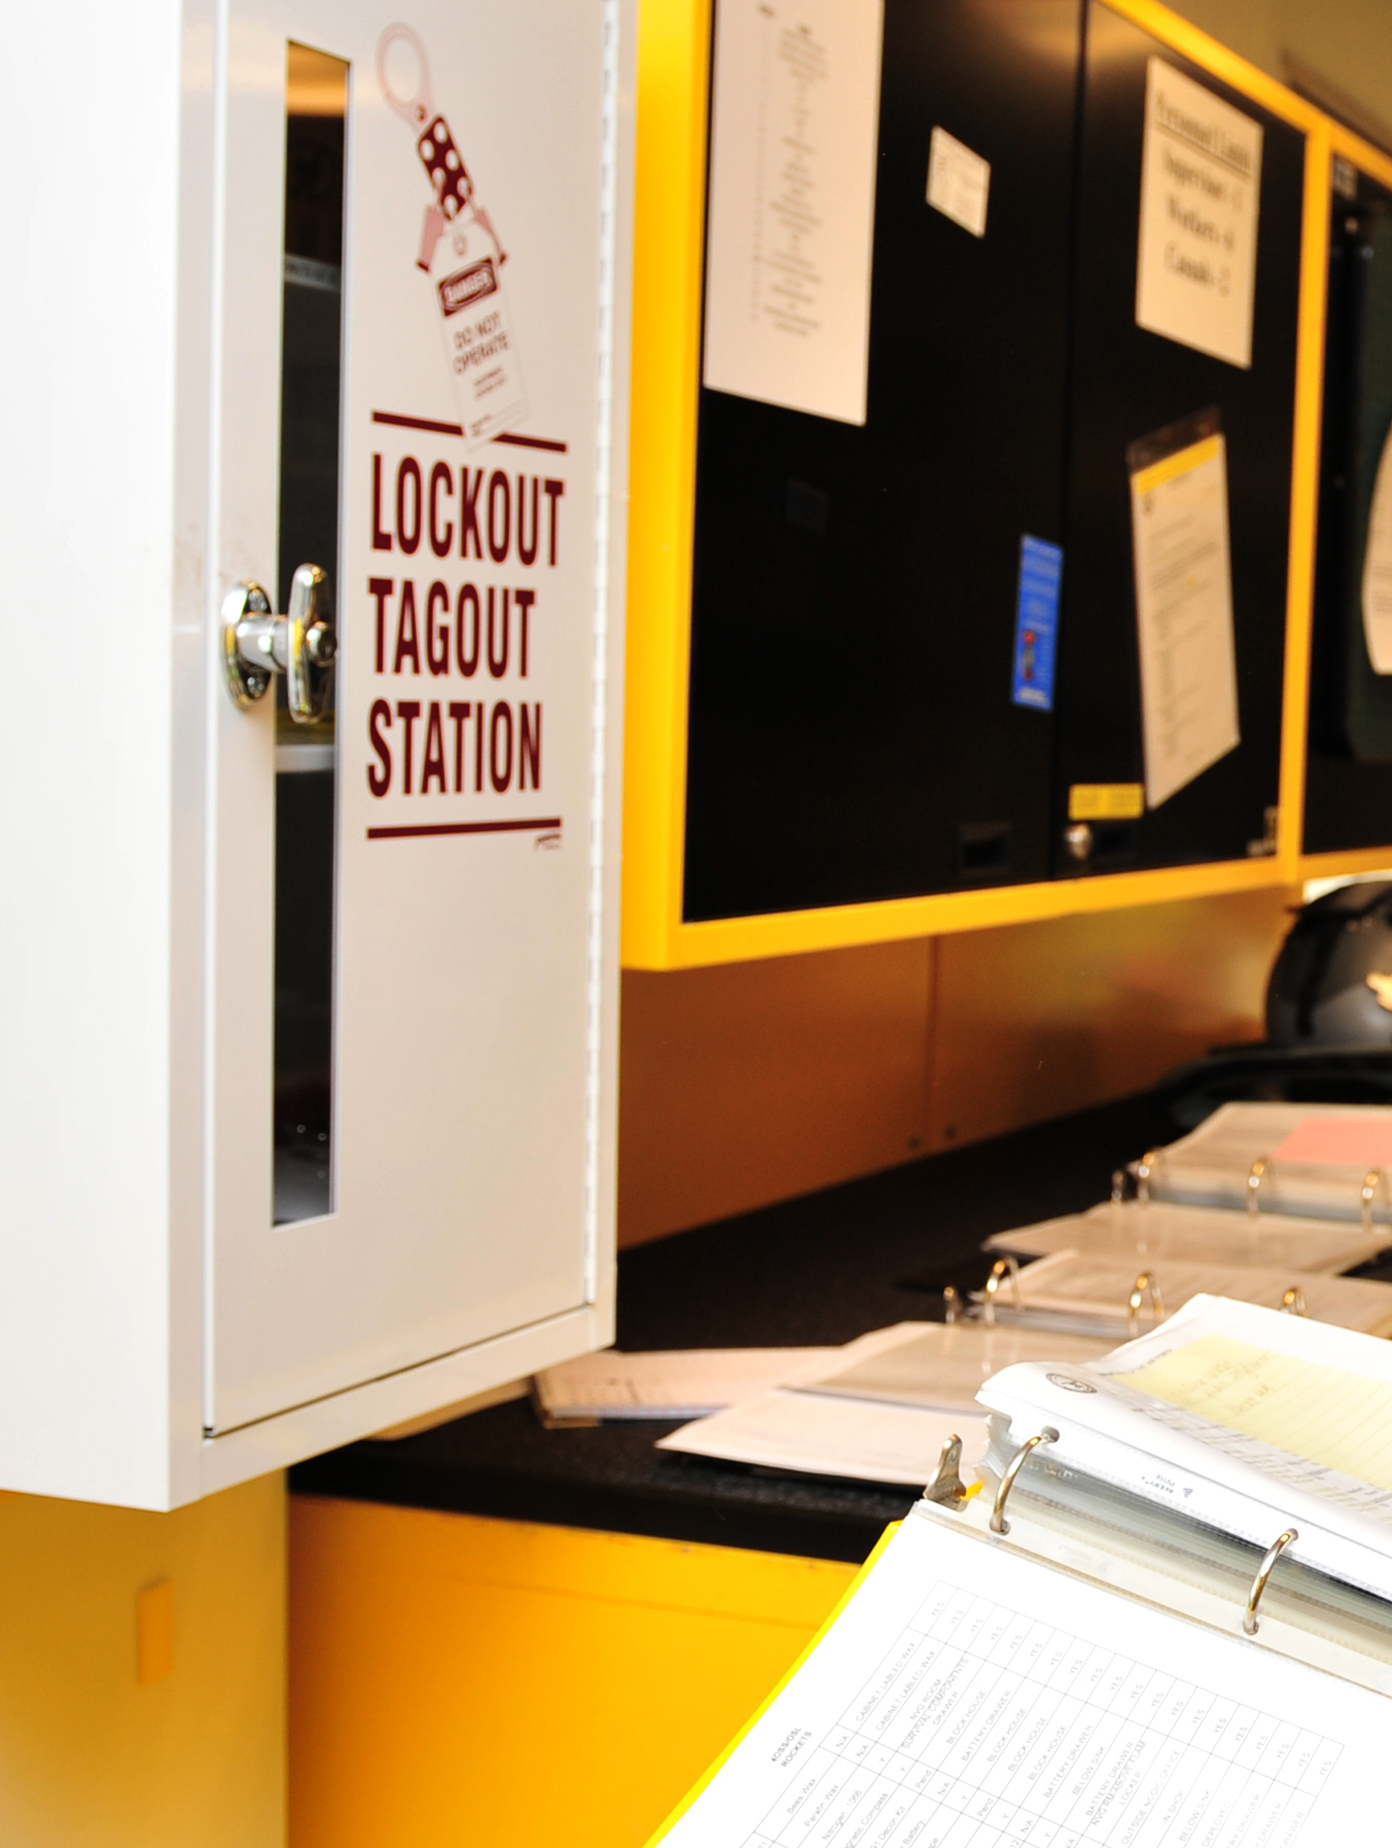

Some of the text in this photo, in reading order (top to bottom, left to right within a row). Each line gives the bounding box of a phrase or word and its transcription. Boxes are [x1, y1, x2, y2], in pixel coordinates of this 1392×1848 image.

[453, 330, 511, 376] OPERATE
[372, 453, 566, 566] LOCKOUT
[369, 578, 535, 678] TAGOUT
[368, 699, 541, 798] STATION
[930, 1601, 945, 1617] YES
[950, 1609, 964, 1625] YES
[969, 1617, 983, 1633] YES
[989, 1625, 1003, 1641] YES
[1008, 1634, 1023, 1649] YES
[1028, 1642, 1043, 1658] YES
[1048, 1650, 1063, 1666] YES
[1068, 1658, 1083, 1674] YES
[854, 1689, 883, 1721] CABINET
[899, 1642, 916, 1660] WAX
[1088, 1667, 1103, 1682] YES
[1108, 1675, 1123, 1691] YES
[874, 1697, 903, 1730] CABINET
[919, 1650, 936, 1669] WAX
[921, 1678, 943, 1702] ROOM
[1129, 1683, 1143, 1699] YES
[1149, 1691, 1164, 1707] YES
[931, 1690, 960, 1725] DRAWER
[945, 1689, 987, 1743] BLOCK HOUSE
[1170, 1700, 1184, 1716] YES
[1190, 1708, 1205, 1724] YES
[960, 1690, 1012, 1761] BATTERY DRAWER
[986, 1707, 1027, 1762] BLOCK HOUSE
[1212, 1717, 1227, 1733] YES
[1233, 1725, 1248, 1742] YES
[780, 1730, 813, 1767] ROCKETS
[835, 1734, 849, 1748] N/A
[855, 1743, 869, 1757] N/A
[1006, 1716, 1047, 1771] BLOCK HOUSE
[1253, 1734, 1268, 1750] YES
[1275, 1742, 1290, 1759] YES
[1027, 1724, 1068, 1780] BLOCK HOUSE
[1042, 1724, 1094, 1797] BATTERY DRAWER
[1296, 1751, 1311, 1767] YES
[1070, 1745, 1107, 1795] BELOW SINK
[1317, 1759, 1332, 1776] YES
[914, 1769, 932, 1788] Pend
[937, 1781, 951, 1795] N/A
[1084, 1741, 1135, 1816] BATTERY DRAWER
[1118, 1771, 1142, 1805] LOCKER
[785, 1777, 817, 1814] Bees Wax
[822, 1783, 839, 1801] Wax
[1166, 1789, 1185, 1813] SHOP
[859, 1791, 891, 1826] Compass
[976, 1797, 994, 1816] Pend
[1235, 1793, 1260, 1832] DRAWER
[876, 1817, 898, 1840] Decon
[1020, 1818, 1033, 1833] N/A
[1119, 1808, 1147, 1845] OUTSIDE
[1178, 1810, 1200, 1841] BELOW
[1201, 1801, 1231, 1847] DEPLOYED
[1257, 1802, 1282, 1841] DRAWER
